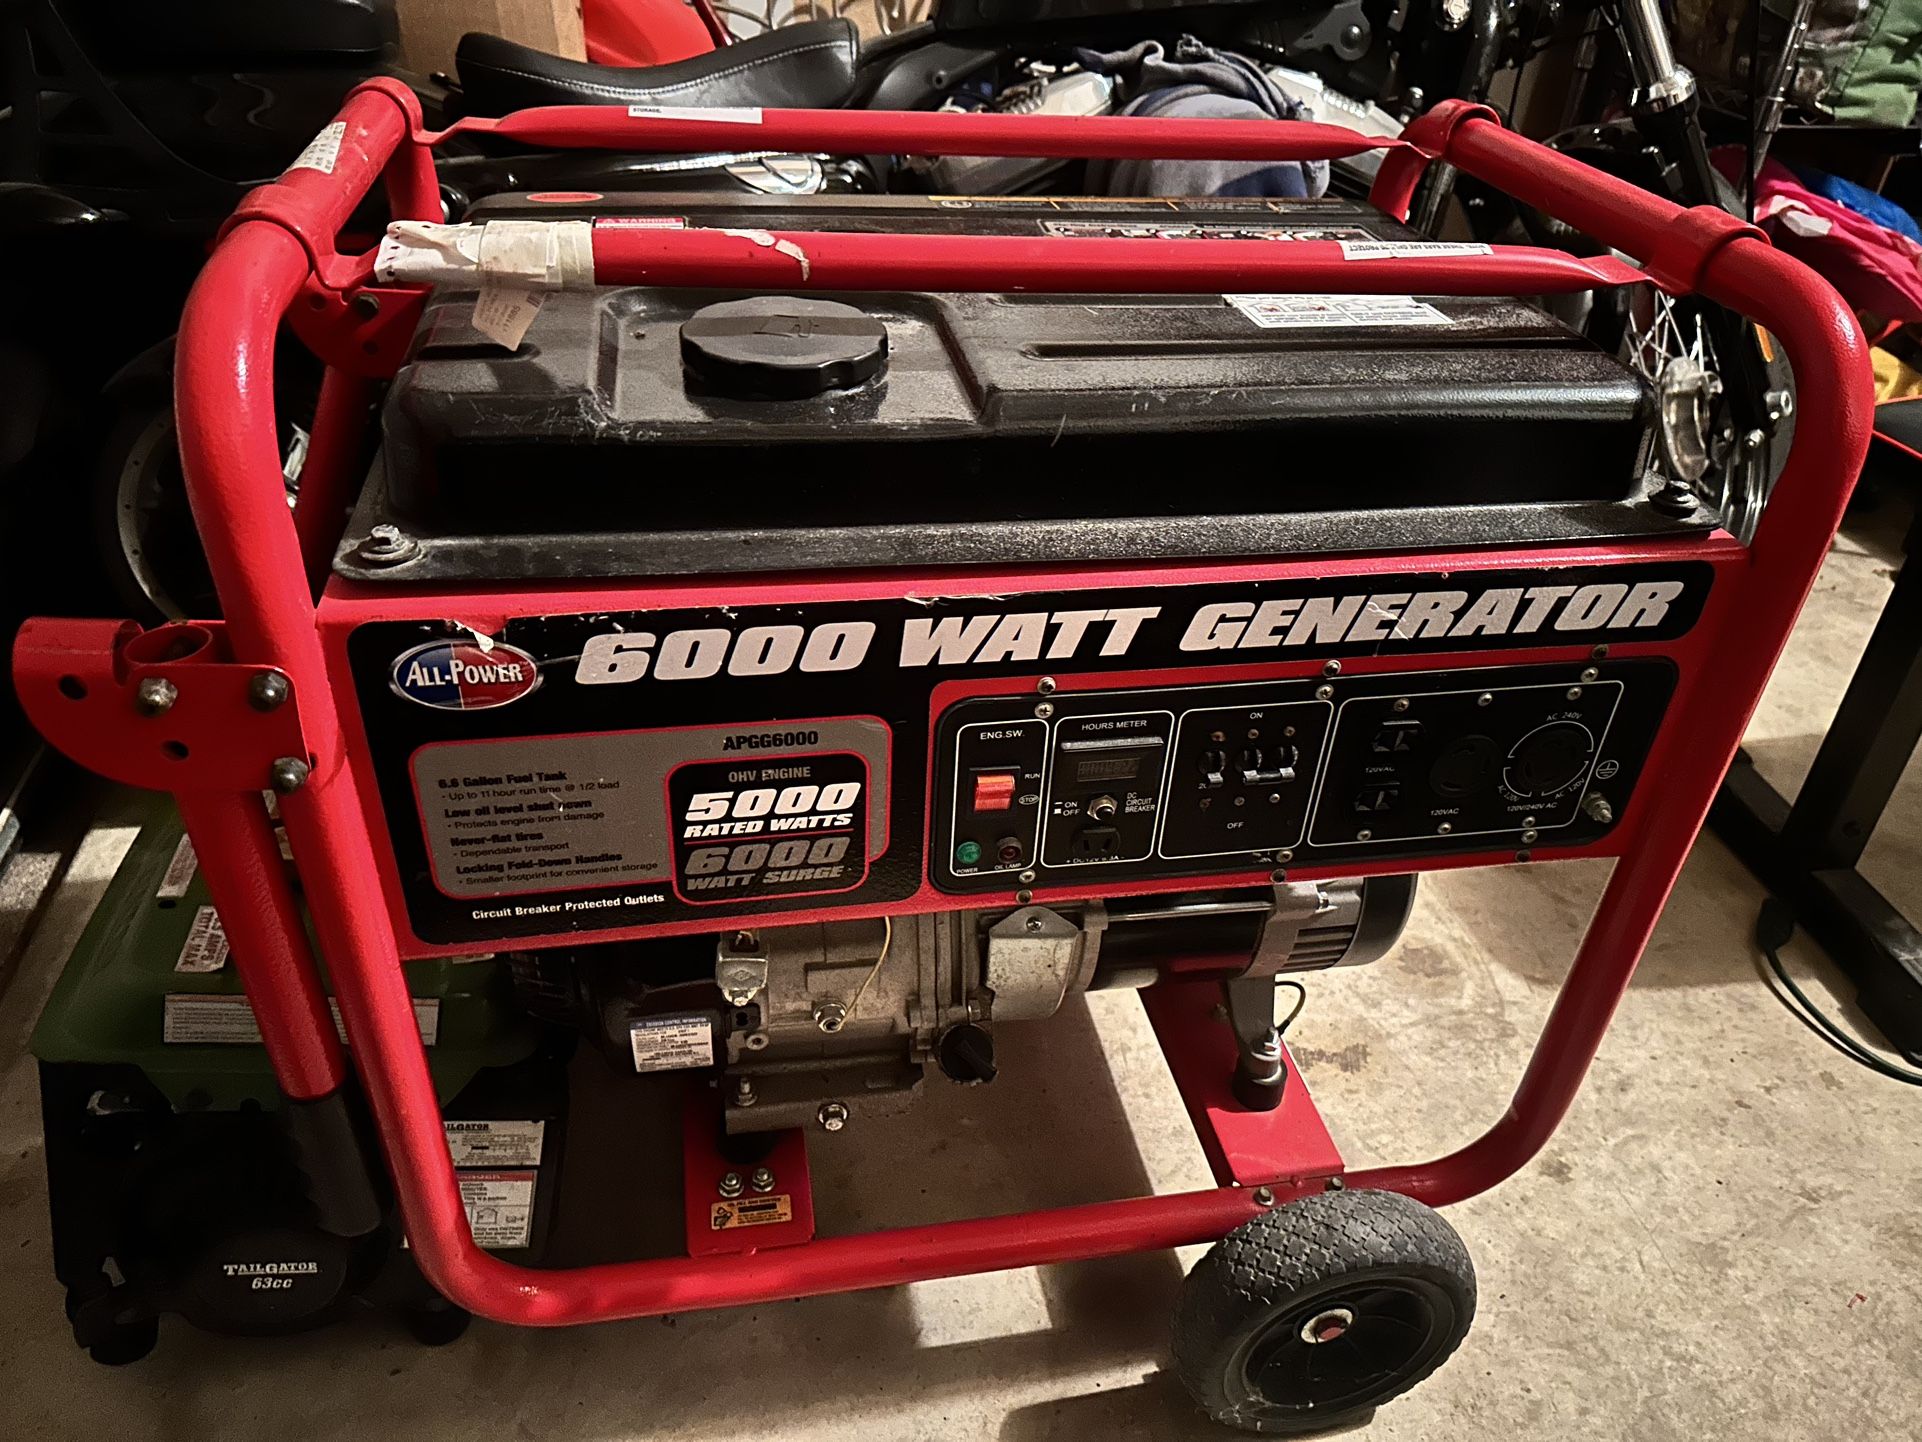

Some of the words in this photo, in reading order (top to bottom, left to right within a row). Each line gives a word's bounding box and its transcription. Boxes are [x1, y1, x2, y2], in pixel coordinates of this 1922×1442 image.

[574, 621, 876, 684] 6000
[898, 607, 1162, 667] WATT
[1178, 580, 1685, 652] GENERATOR
[405, 659, 524, 688] ALL-POWER
[1081, 721, 1114, 731] HOURS
[1116, 719, 1147, 729] METER
[722, 731, 818, 750] APGG6000
[462, 776, 503, 788] Gallon
[507, 773, 533, 784] Fuel
[536, 770, 567, 782] Tank
[728, 769, 756, 783] OHV
[761, 766, 811, 781] ENGINE
[449, 792, 464, 801] Up
[466, 791, 478, 799] to
[480, 790, 490, 798] 11
[492, 788, 516, 798] hour
[519, 787, 537, 796] run
[539, 785, 561, 794] time
[565, 784, 575, 793] @
[579, 782, 595, 791] 1/2
[598, 780, 619, 790] load
[684, 782, 861, 822] 5000
[1021, 795, 1039, 804] STOP
[1126, 797, 1152, 806] CIRCUIT
[1545, 801, 1557, 809] AC
[444, 808, 470, 818] Low
[475, 806, 491, 816] oil
[494, 803, 524, 814] level
[527, 801, 554, 812] shut
[1062, 808, 1080, 816] OFF
[1124, 804, 1155, 813] BREAKER
[1430, 808, 1459, 816] 120VAC
[454, 819, 498, 830] Protects
[500, 817, 535, 828] engine
[538, 814, 561, 823] from
[563, 811, 604, 822] damage
[683, 820, 764, 839] RATED
[769, 813, 853, 831] WATTS
[1227, 821, 1244, 829] OFF
[515, 831, 543, 842] tires
[460, 846, 522, 858] Dependable
[525, 842, 569, 853] transport
[684, 836, 850, 875] 6000
[456, 863, 504, 875] Locking
[507, 857, 572, 870] Fold-Down
[575, 852, 622, 864] Handles
[466, 875, 504, 885] Smaller
[506, 872, 547, 883] footprint
[550, 870, 563, 878] for
[565, 864, 619, 876] convenient
[621, 861, 657, 873] storage
[686, 873, 756, 891] WATT
[762, 865, 845, 884] SURGE
[472, 908, 511, 920] Circuit
[515, 902, 561, 915] Breaker
[565, 898, 620, 911] Protected
[624, 893, 664, 906] Outlets
[223, 1262, 318, 1275] TAILGATOR
[251, 1277, 293, 1289] 63cc
